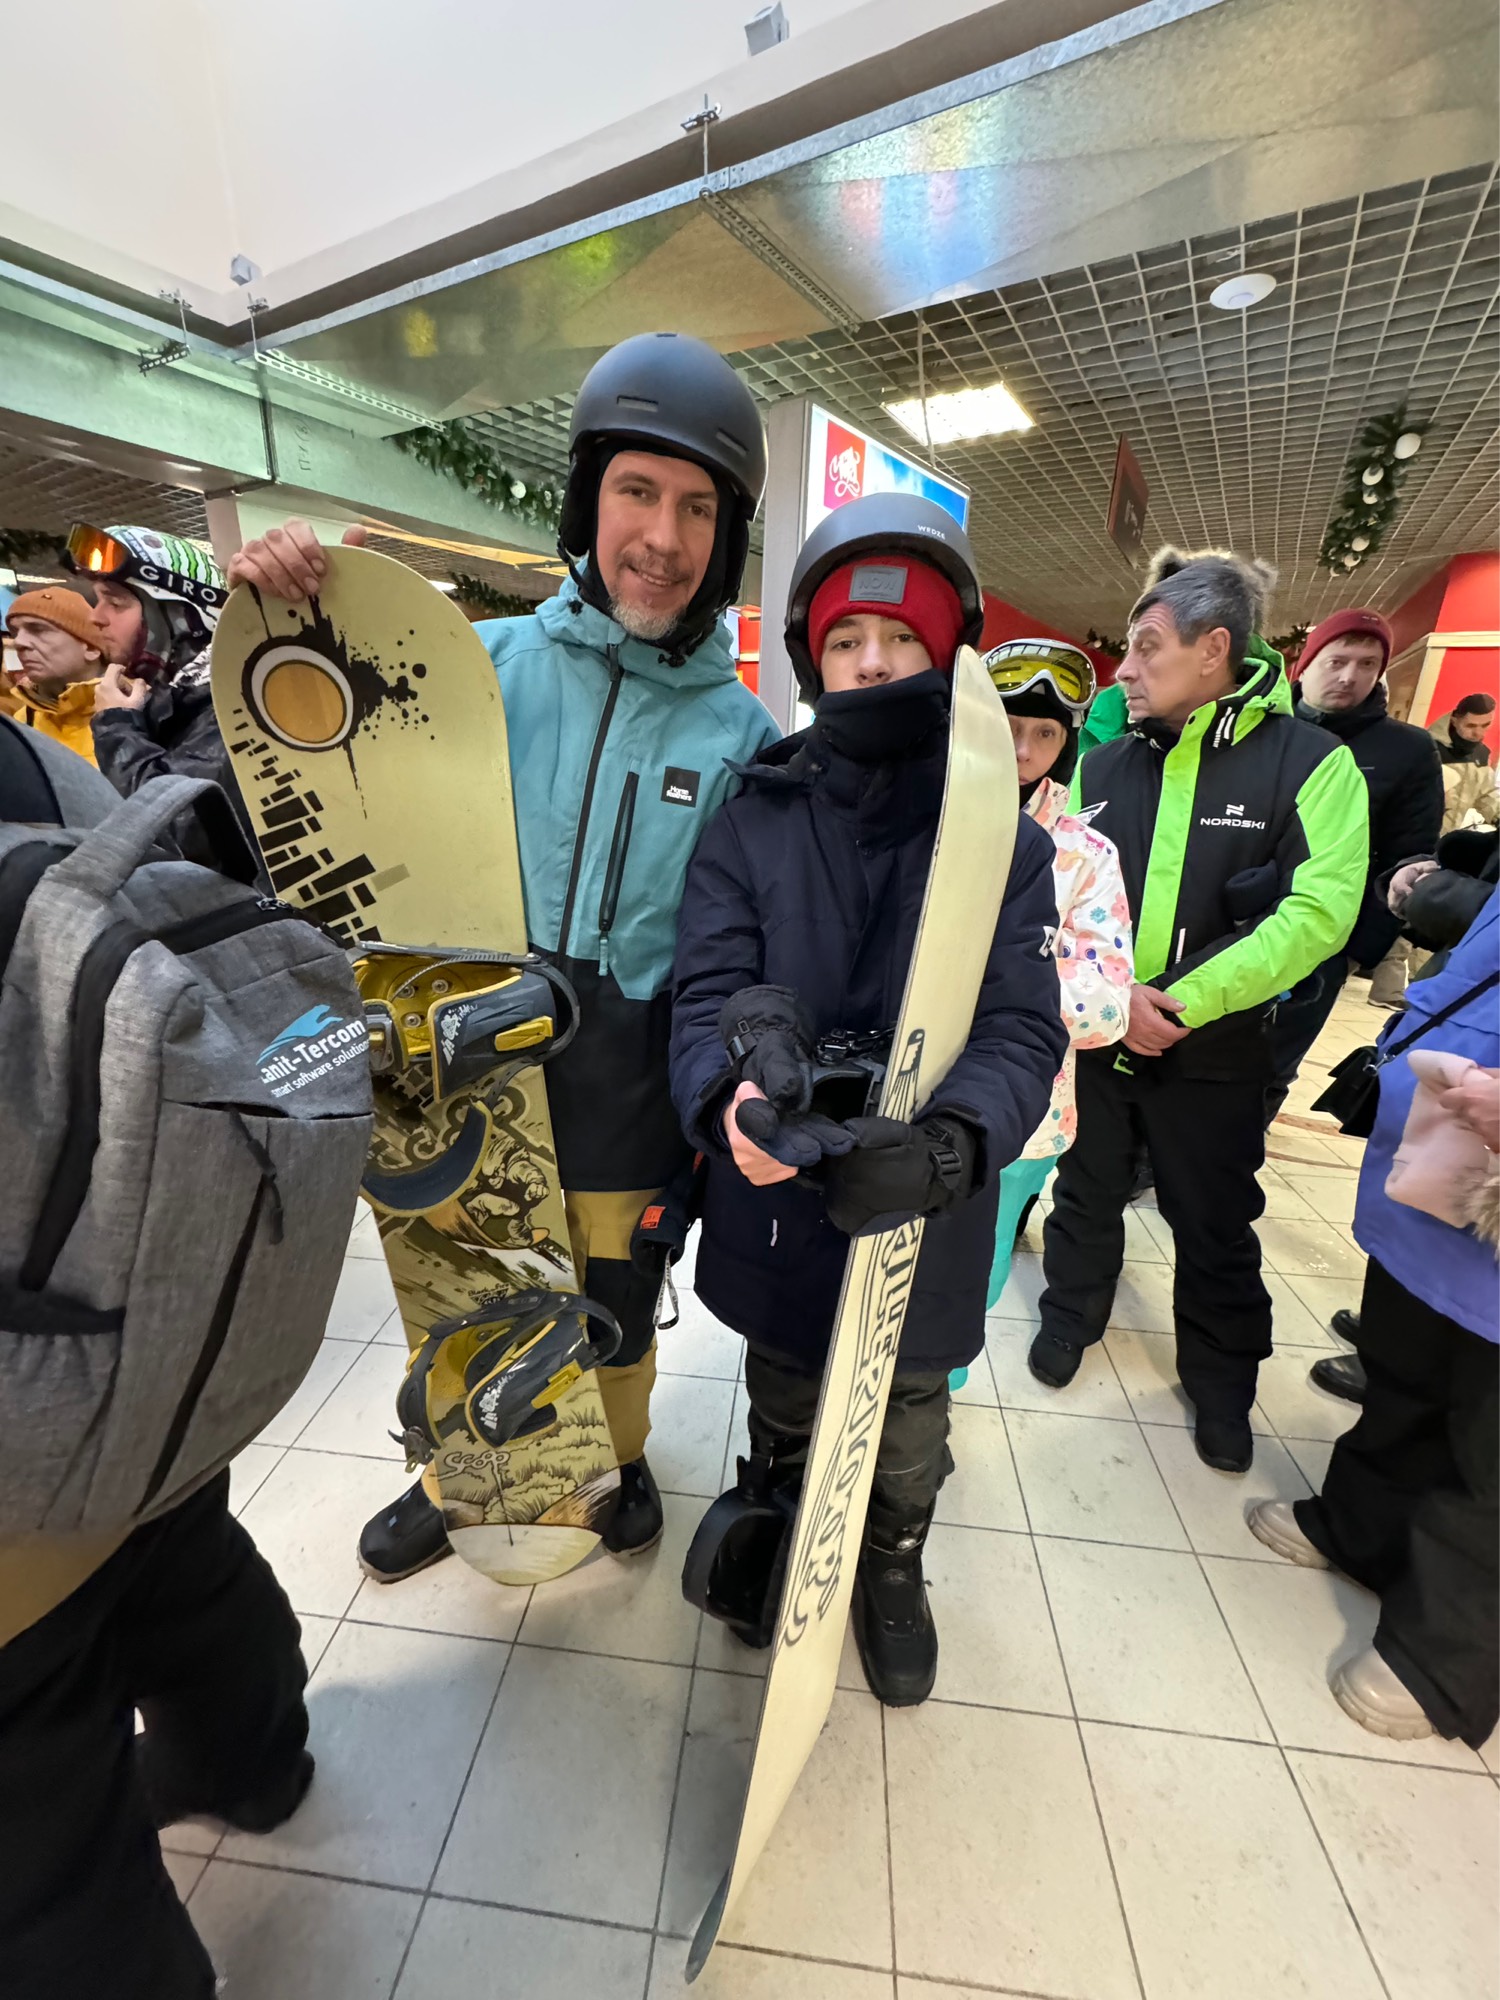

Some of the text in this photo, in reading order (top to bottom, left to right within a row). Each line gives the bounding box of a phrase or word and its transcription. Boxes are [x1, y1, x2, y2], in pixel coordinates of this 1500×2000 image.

[917, 524, 946, 540] WEDZE
[139, 564, 217, 603] GIRO
[1200, 817, 1266, 830] NORDSKI
[270, 1081, 295, 1098] smart
[293, 1063, 334, 1089] software
